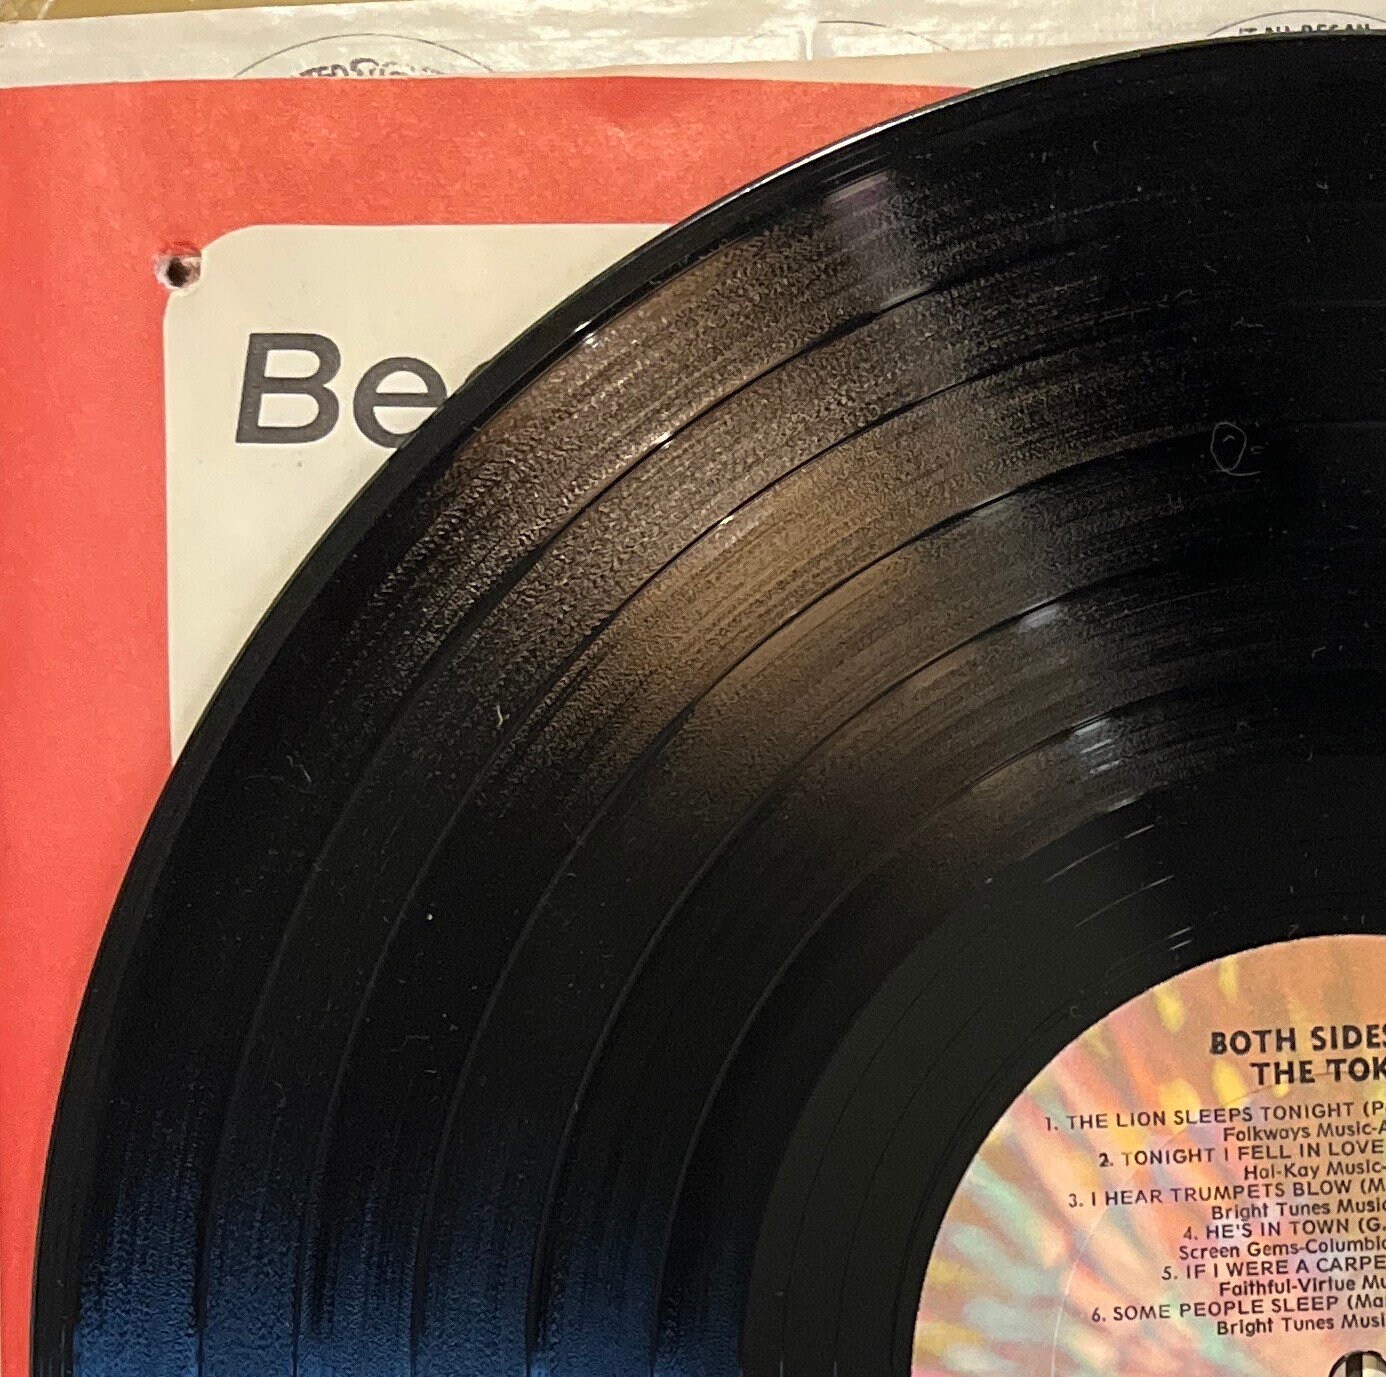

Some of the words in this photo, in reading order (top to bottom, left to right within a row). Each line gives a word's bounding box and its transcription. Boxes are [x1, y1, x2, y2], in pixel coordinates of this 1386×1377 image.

[1210, 1027, 1297, 1055] BOTH
[1250, 1060, 1315, 1085] THE
[1045, 1117, 1058, 1131] 1.
[1067, 1113, 1108, 1130] THE
[1117, 1111, 1166, 1129] LION
[1174, 1107, 1252, 1126] SLEEPS
[1260, 1102, 1354, 1122] TONIGHT
[1223, 1123, 1310, 1142] Folkways
[1099, 1153, 1113, 1167] 2.
[1121, 1148, 1215, 1167] TONIGHT
[1224, 1147, 1229, 1161] I
[1238, 1144, 1291, 1161] FELL
[1300, 1142, 1320, 1158] IN
[1329, 1138, 1383, 1157] LOVE
[1244, 1162, 1318, 1181] Hal-Kay
[1069, 1193, 1083, 1208] 3.
[1091, 1191, 1096, 1206] I
[1105, 1188, 1163, 1206] HEAR
[1170, 1183, 1285, 1203] TRUMPETS
[1293, 1179, 1352, 1197] BLOW
[1212, 1205, 1268, 1222] Bright
[1277, 1202, 1331, 1217] Tunes
[1183, 1227, 1198, 1241] 4.
[1206, 1223, 1252, 1239] HE'S
[1261, 1221, 1281, 1237] IN
[1289, 1218, 1349, 1236] TOWN
[1179, 1244, 1240, 1260] Screen
[1162, 1267, 1178, 1281] 5.
[1186, 1263, 1206, 1279] IF
[1214, 1262, 1219, 1277] I
[1226, 1258, 1289, 1277] WERE
[1296, 1258, 1310, 1274] A
[1219, 1275, 1356, 1297] Faithful-Virtue
[1091, 1309, 1106, 1323] 6.
[1113, 1304, 1171, 1321] SOME
[1179, 1298, 1263, 1317] PEOPLE
[1271, 1295, 1338, 1312] SLEEP
[1217, 1321, 1273, 1337] Bright
[1282, 1317, 1334, 1332] Tunes
